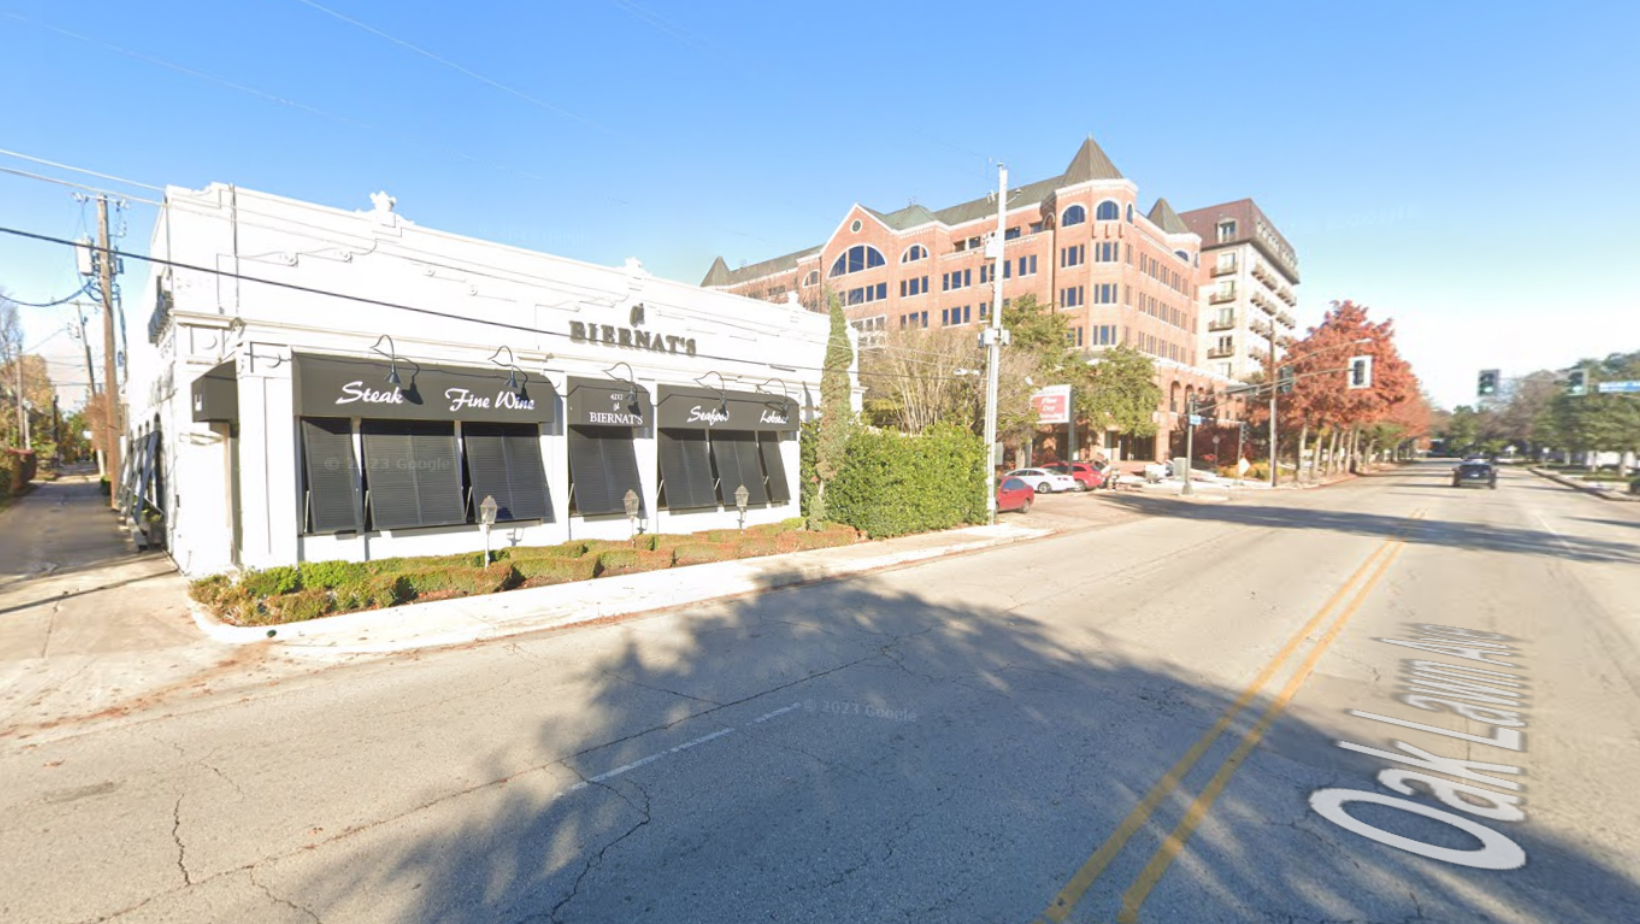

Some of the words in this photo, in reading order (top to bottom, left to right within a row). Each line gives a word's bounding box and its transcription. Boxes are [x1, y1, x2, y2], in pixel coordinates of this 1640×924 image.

[569, 320, 697, 358] BIERNAT'S
[335, 380, 403, 404] Steak
[444, 388, 490, 411] Fine
[495, 391, 534, 410] Wine
[589, 412, 643, 425] BIERNAT'S
